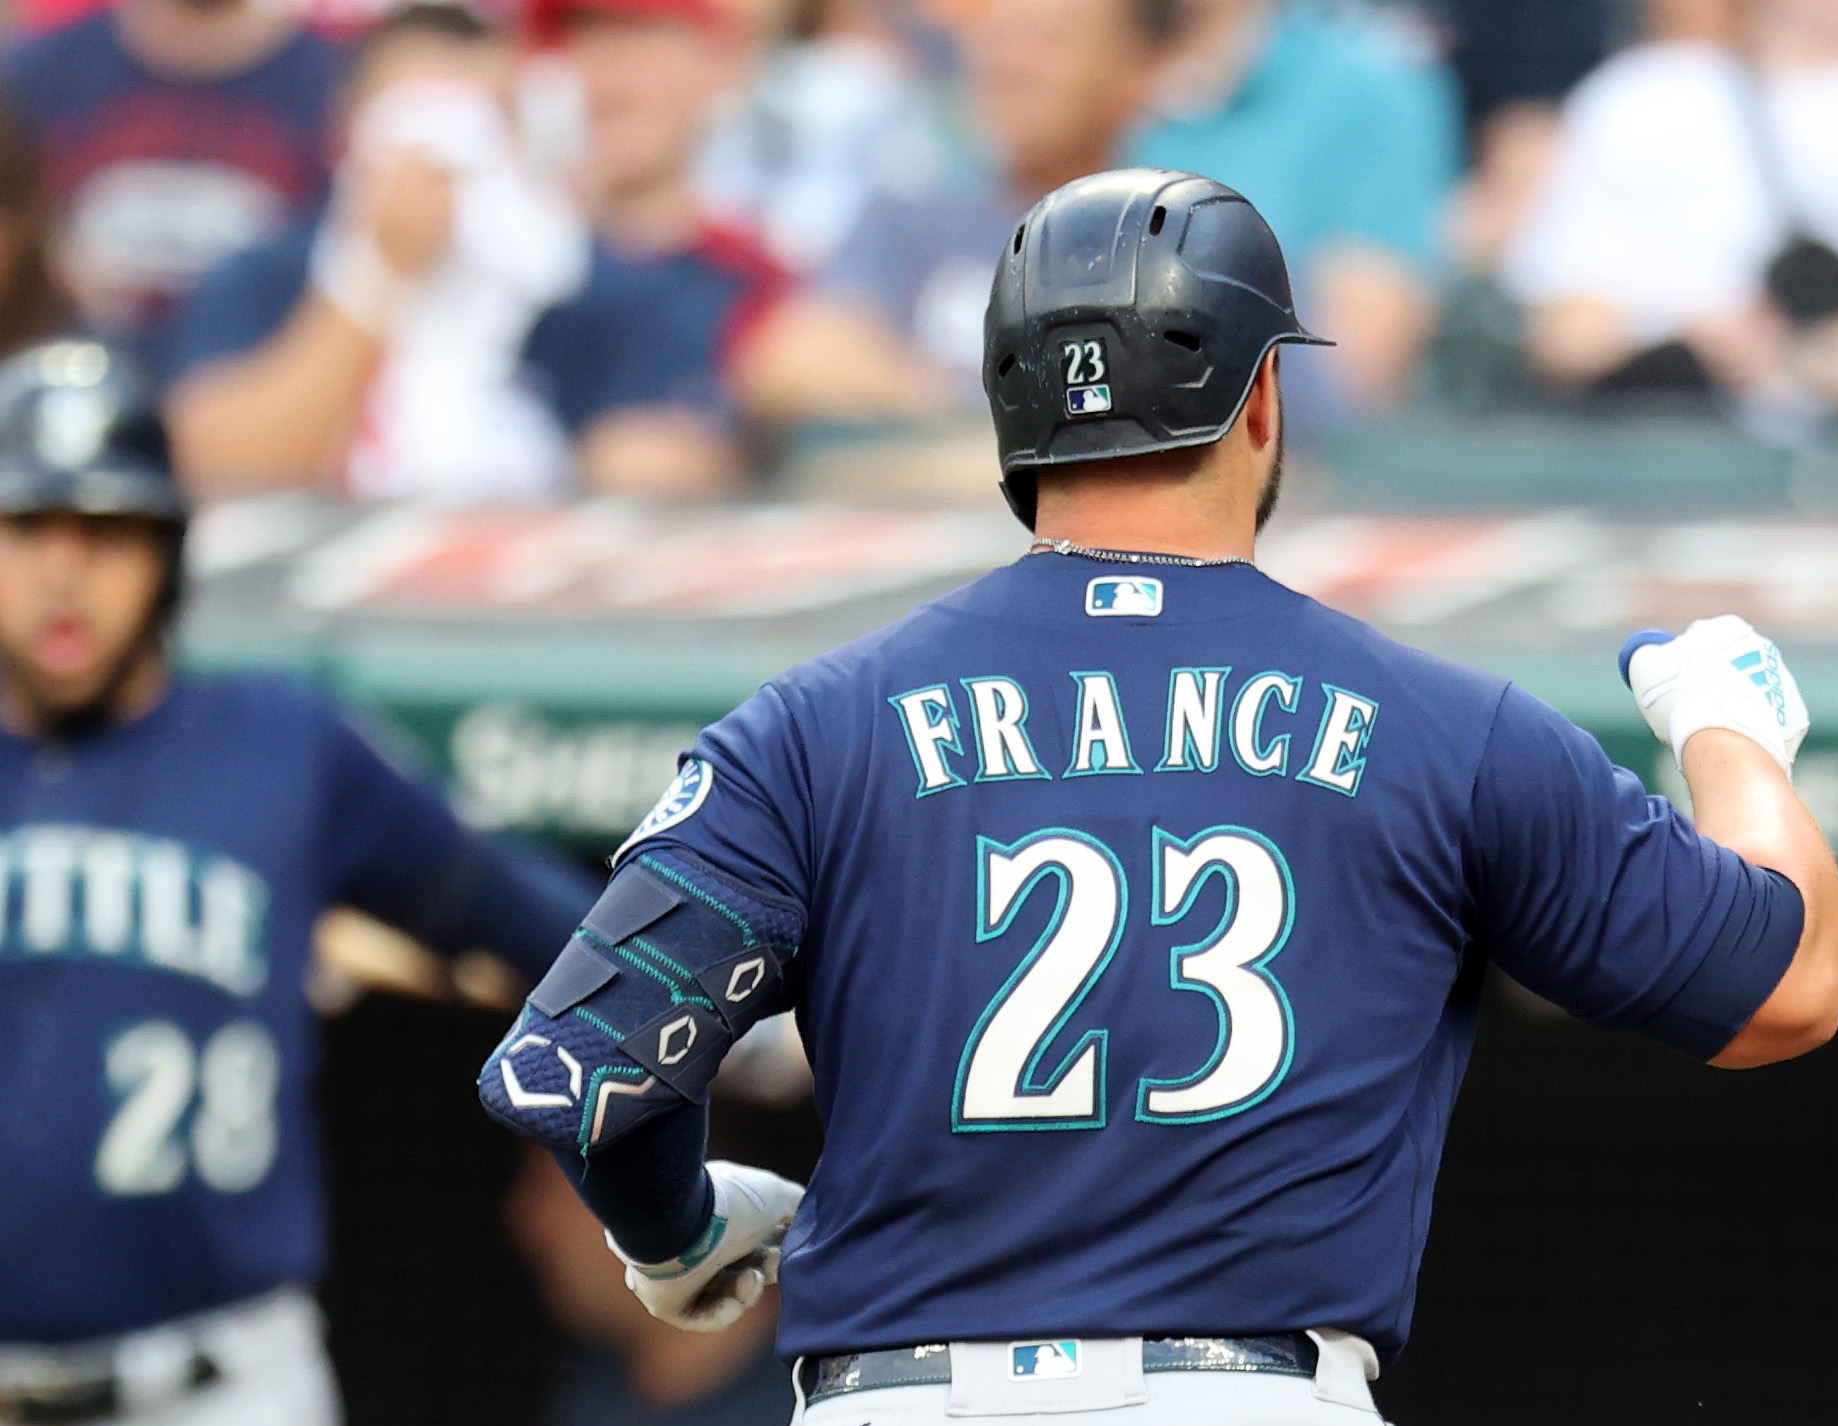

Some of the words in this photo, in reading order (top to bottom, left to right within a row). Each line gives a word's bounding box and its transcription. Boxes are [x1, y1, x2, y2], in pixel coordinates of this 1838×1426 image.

[1062, 340, 1106, 384] 23
[888, 666, 1380, 799] FRANCE
[1763, 641, 1787, 728] adidas
[0, 822, 270, 998] TTLE
[951, 824, 1297, 1133] 23
[95, 1018, 282, 1197] 28
